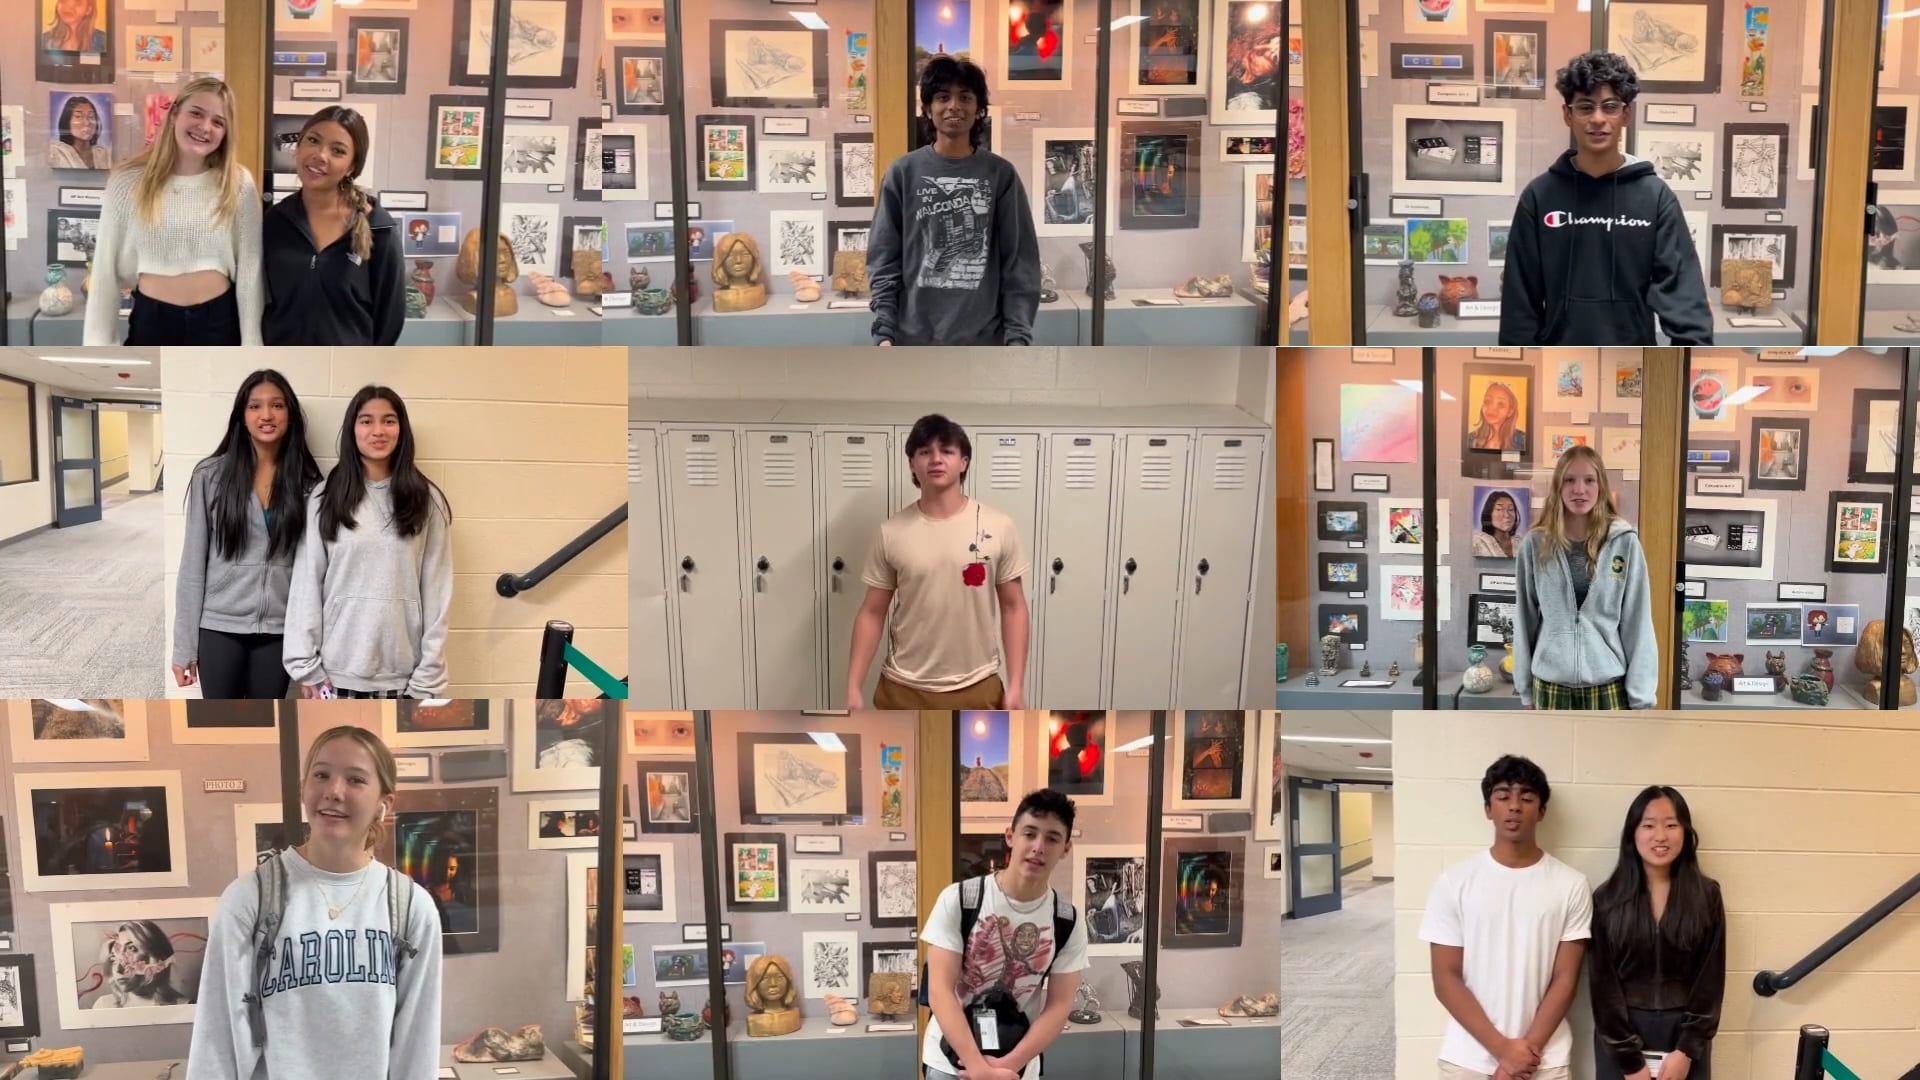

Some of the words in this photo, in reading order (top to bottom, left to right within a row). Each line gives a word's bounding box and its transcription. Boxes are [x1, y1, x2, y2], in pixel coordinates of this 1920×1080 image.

[916, 188, 938, 196] LIVE
[1543, 210, 1652, 232] Champion
[206, 781, 236, 789] PHOTO
